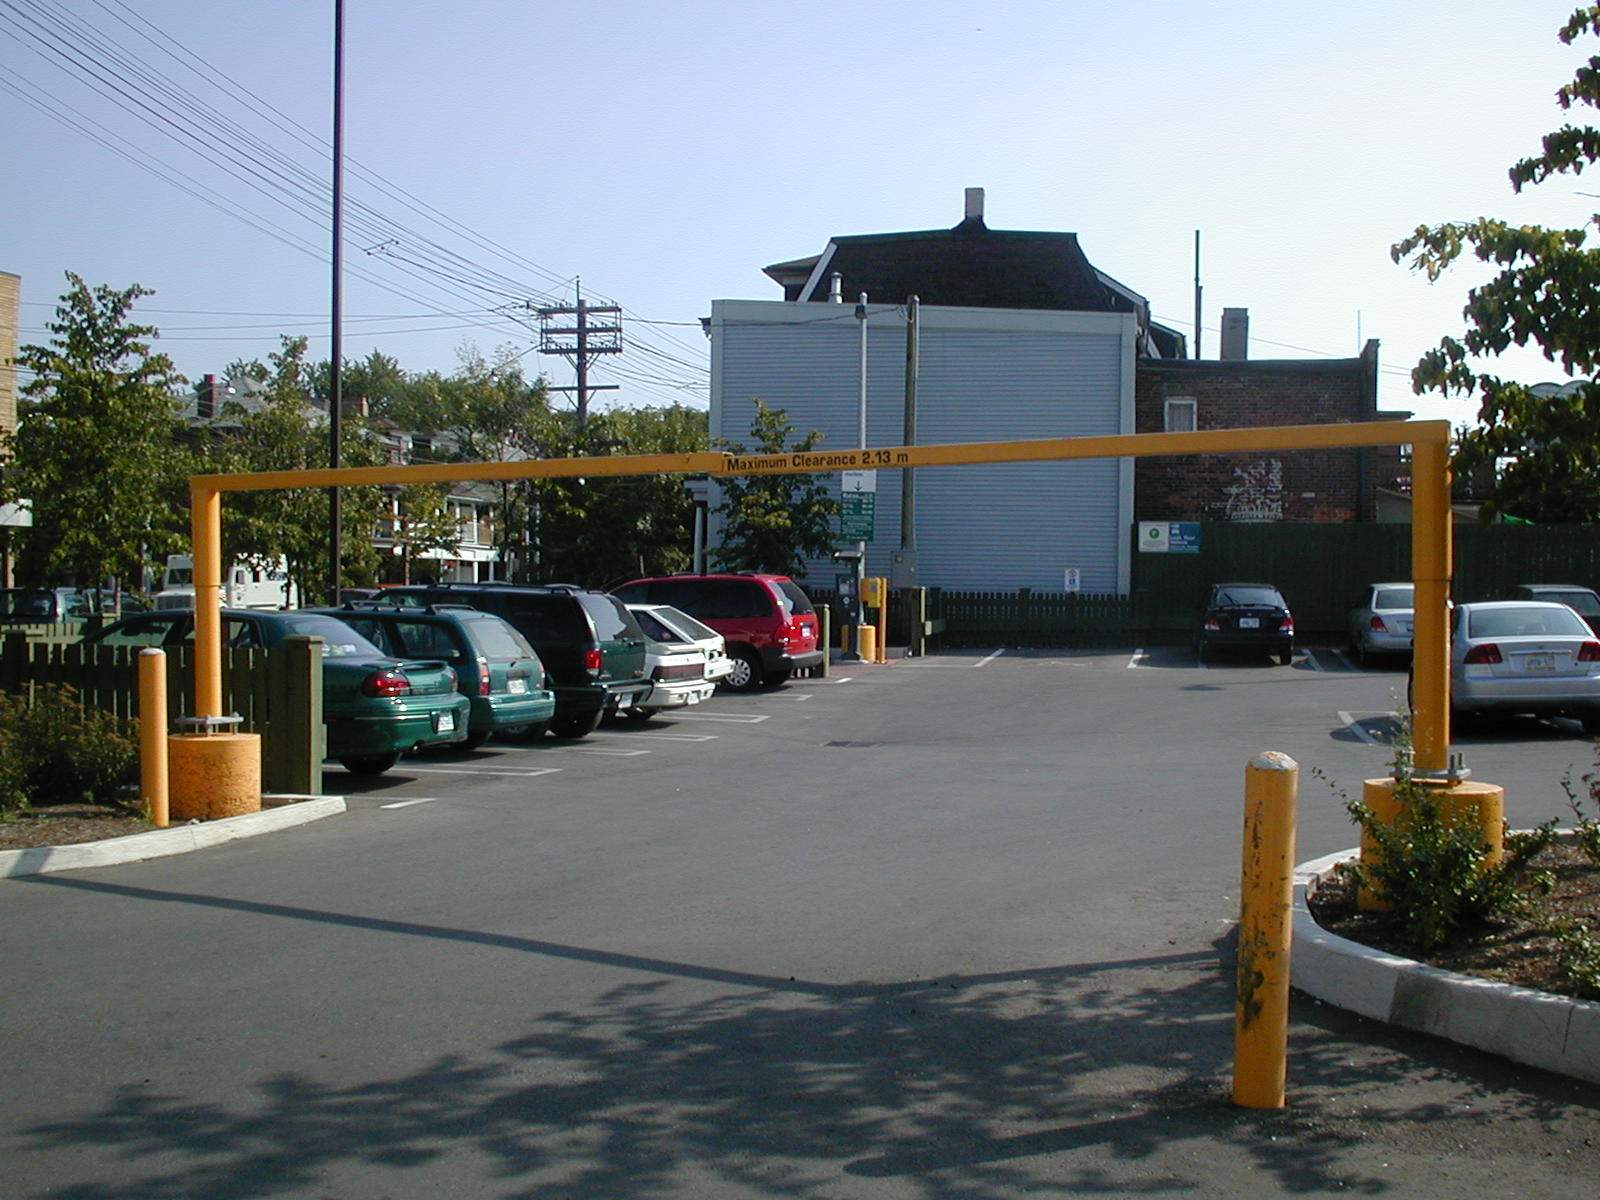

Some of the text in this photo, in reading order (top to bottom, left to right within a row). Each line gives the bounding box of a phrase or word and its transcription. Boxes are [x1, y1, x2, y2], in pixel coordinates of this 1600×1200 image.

[727, 451, 909, 471] Maximum Clearance 2.13 m
